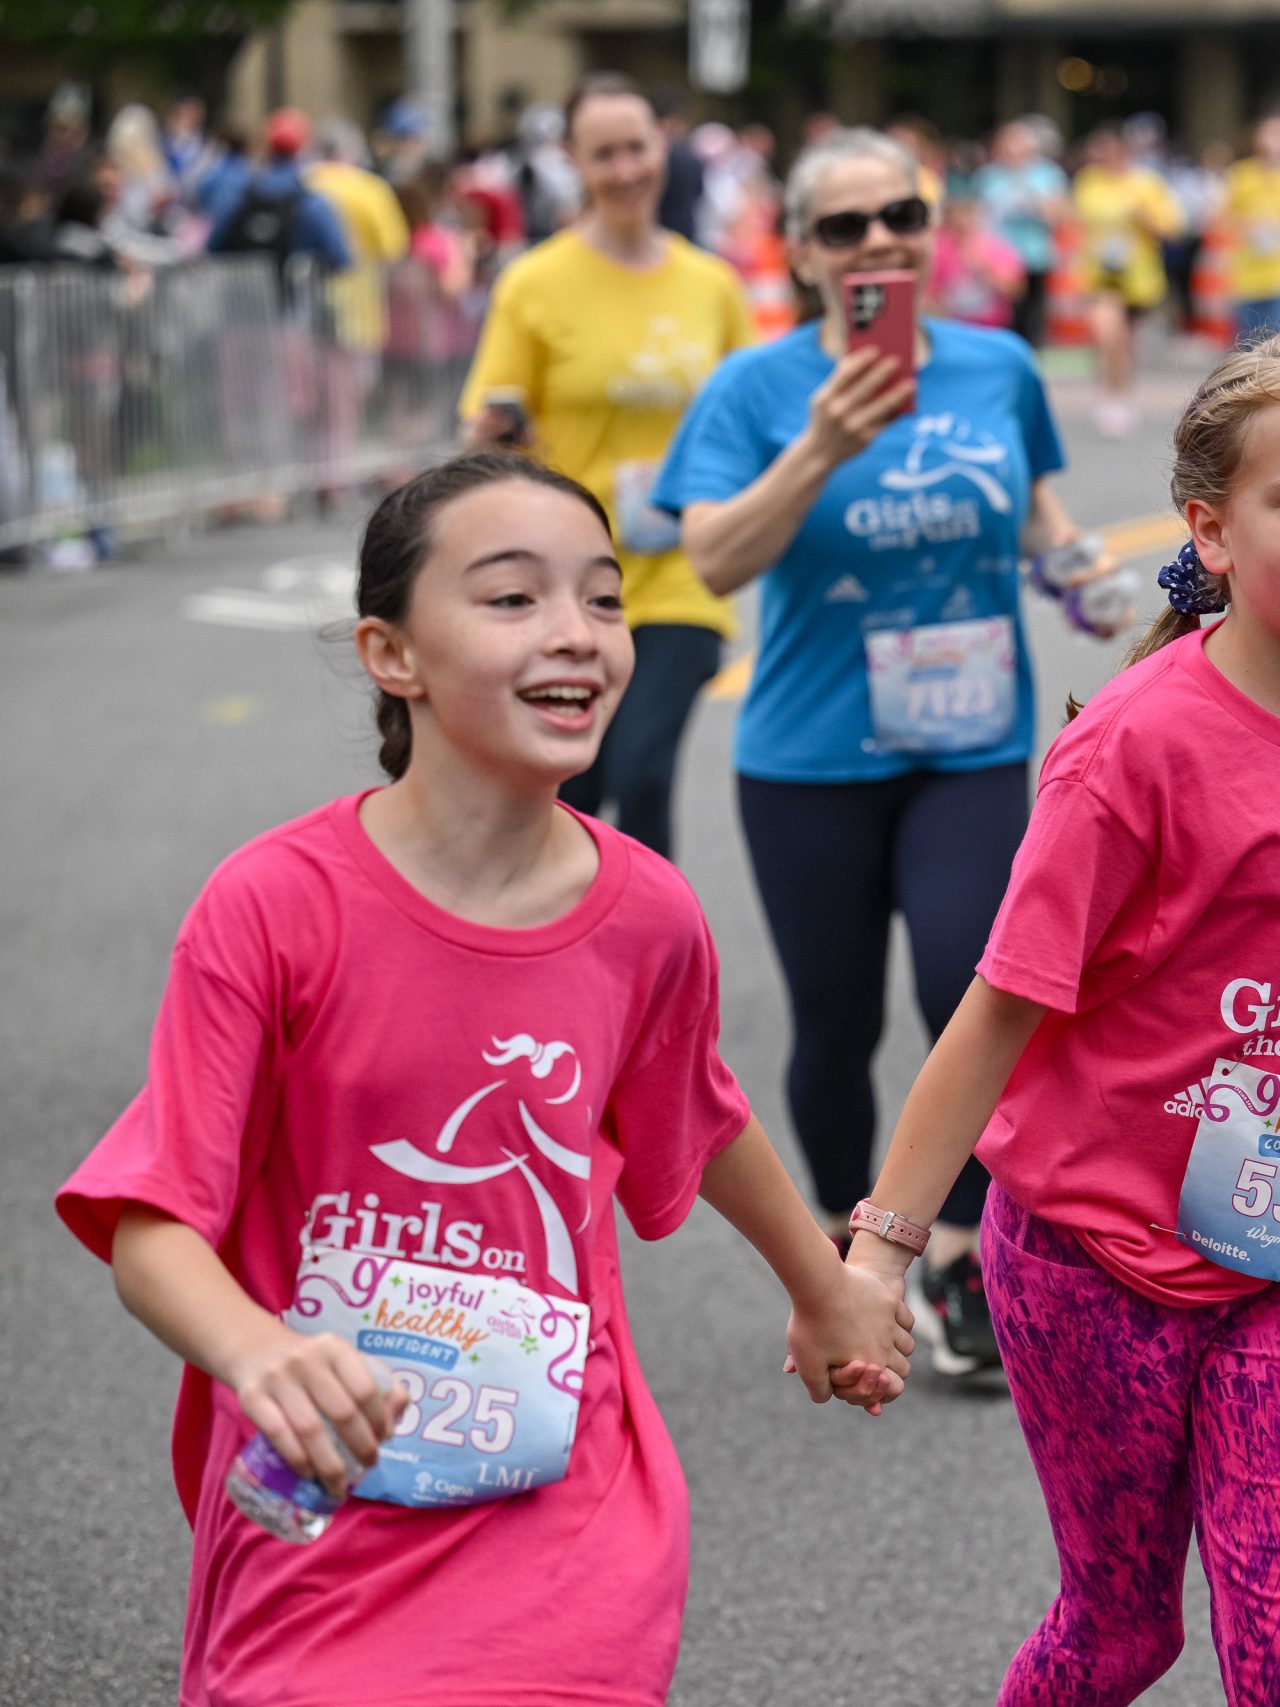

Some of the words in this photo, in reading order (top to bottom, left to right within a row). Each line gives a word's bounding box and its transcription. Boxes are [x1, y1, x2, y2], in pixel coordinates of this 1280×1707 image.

[299, 1191, 483, 1268] Girls
[481, 1246, 526, 1272] on
[1192, 1230, 1251, 1262] Deloitte.
[406, 1277, 485, 1310] joyful
[374, 1297, 491, 1352] healthy
[362, 1331, 456, 1362] CONFIDENT
[434, 1479, 475, 1498] Cigna
